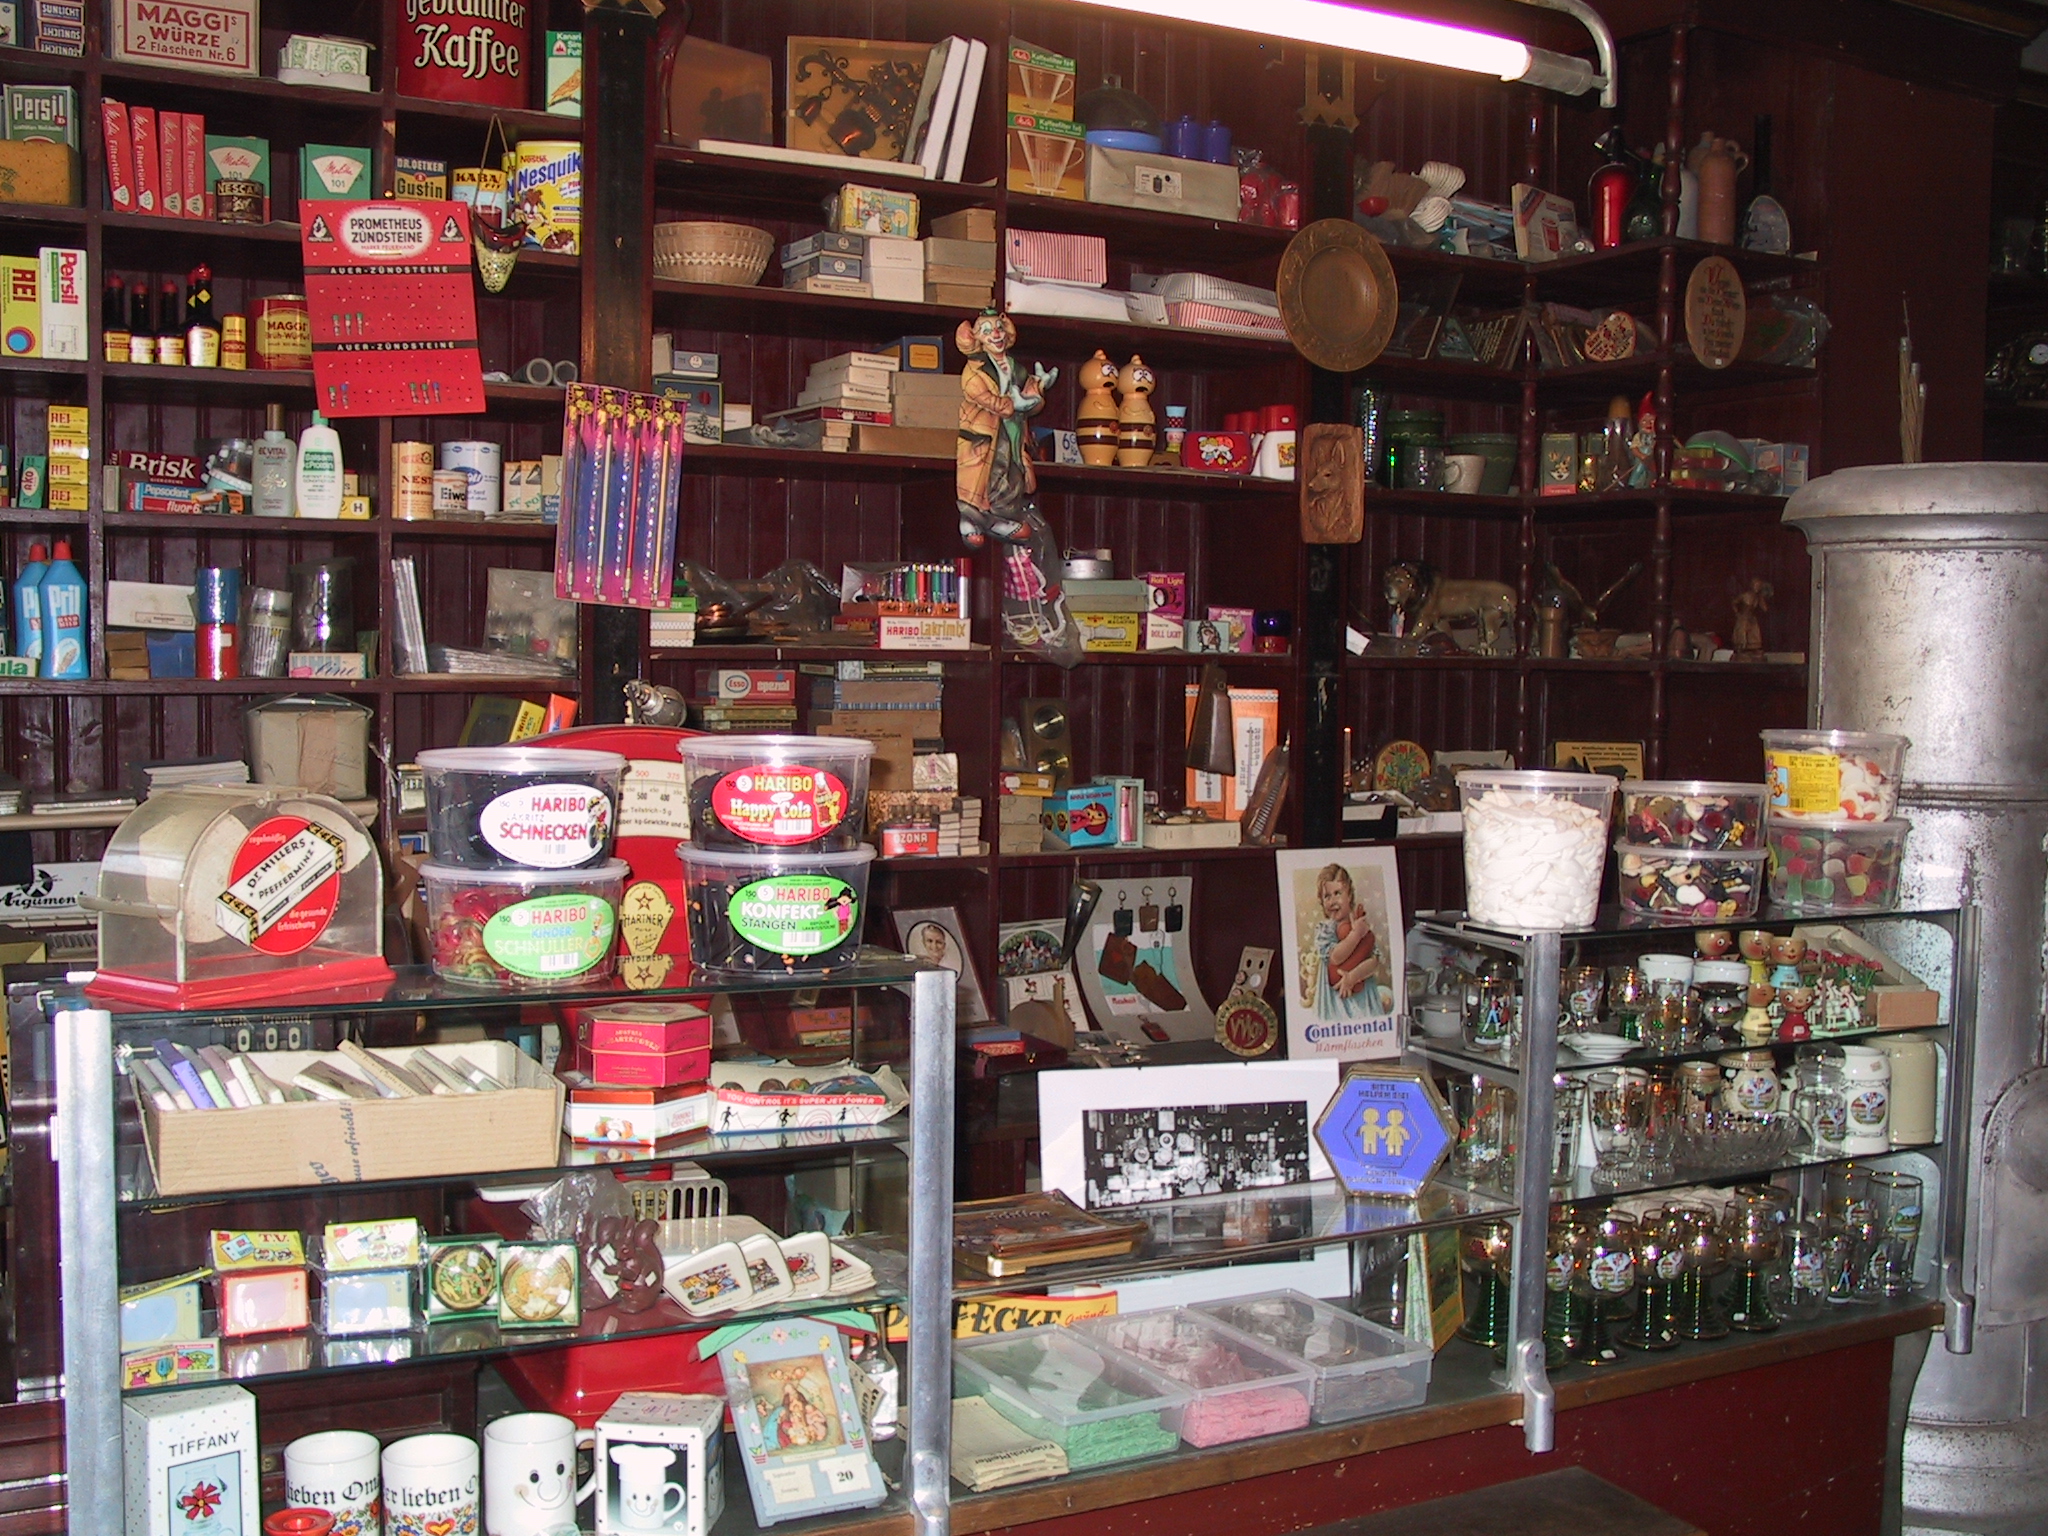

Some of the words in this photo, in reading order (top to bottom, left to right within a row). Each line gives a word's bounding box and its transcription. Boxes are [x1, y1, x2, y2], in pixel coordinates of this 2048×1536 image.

[42, 4, 80, 17] SUNLICHT
[43, 26, 81, 40] SUNLICHT
[149, 25, 221, 48] WÜRZE
[136, 35, 146, 50] 2
[150, 41, 204, 58] Flaschen
[208, 50, 225, 62] Nr.
[226, 46, 236, 62] 6
[414, 23, 520, 79] Kaffee
[13, 93, 64, 121] Persil
[108, 139, 121, 187] Filtertüten
[135, 145, 145, 192] Filtertüten
[165, 149, 173, 192] Filtertüten
[397, 158, 445, 174] DR.OETKER
[187, 150, 196, 193] Filtertüten
[228, 170, 243, 180] 101
[518, 151, 582, 192] Nesquik
[332, 179, 346, 188] 101
[397, 177, 443, 199] Gustin
[350, 218, 422, 230] PROMETHEUS
[351, 230, 423, 243] ZÜNDSTEINE
[60, 252, 79, 304] Persil
[330, 265, 448, 275] AUER-ZÜNDSTEINE
[12, 268, 36, 303] REI
[267, 320, 308, 331] MAGGI
[337, 342, 455, 351] AUER-ZÜNDSTEINE
[51, 412, 71, 424] REI
[51, 465, 71, 476] REI
[129, 453, 196, 479] Brisk
[51, 489, 71, 501] REI
[145, 483, 190, 498] Pepsodent
[353, 503, 363, 512] H
[22, 586, 40, 618] Pr
[48, 585, 80, 616] Pril
[886, 626, 920, 636] HARIBO
[728, 678, 746, 688] Esso
[636, 769, 650, 778] 500
[755, 775, 813, 792] HARIBO
[531, 797, 586, 812] HARIBO
[730, 797, 777, 822] Happy
[779, 799, 812, 818] Cola
[499, 821, 588, 841] SCHNECKEN
[893, 833, 928, 844] OZONA
[261, 838, 306, 873] HILLERS
[258, 849, 315, 900] PFEFFERMINZ
[776, 886, 831, 902] HARIBO
[531, 906, 587, 925] HARIBO
[741, 901, 825, 920] KONFEKT-
[277, 920, 316, 932] Erfrischung
[622, 914, 664, 929] HARTNER
[741, 917, 796, 930] STANGEN
[494, 936, 584, 955] SCHNULLER
[1304, 1017, 1394, 1044] Continental
[1315, 1038, 1384, 1053] Wärmflaschen
[1371, 1083, 1396, 1091] BITTE
[726, 1092, 743, 1103] YOU
[745, 1096, 781, 1106] CONTROL
[798, 1096, 826, 1105] SUPER
[827, 1096, 843, 1105] JET
[845, 1096, 875, 1104] POWER
[258, 1233, 290, 1243] T.V.
[168, 1430, 240, 1457] TIFFANY
[669, 1442, 688, 1452] MUG
[836, 1470, 854, 1483] 20
[286, 1479, 336, 1506] lieben
[342, 1477, 380, 1501] Om
[382, 1487, 398, 1505] er
[402, 1486, 460, 1508] lieben
